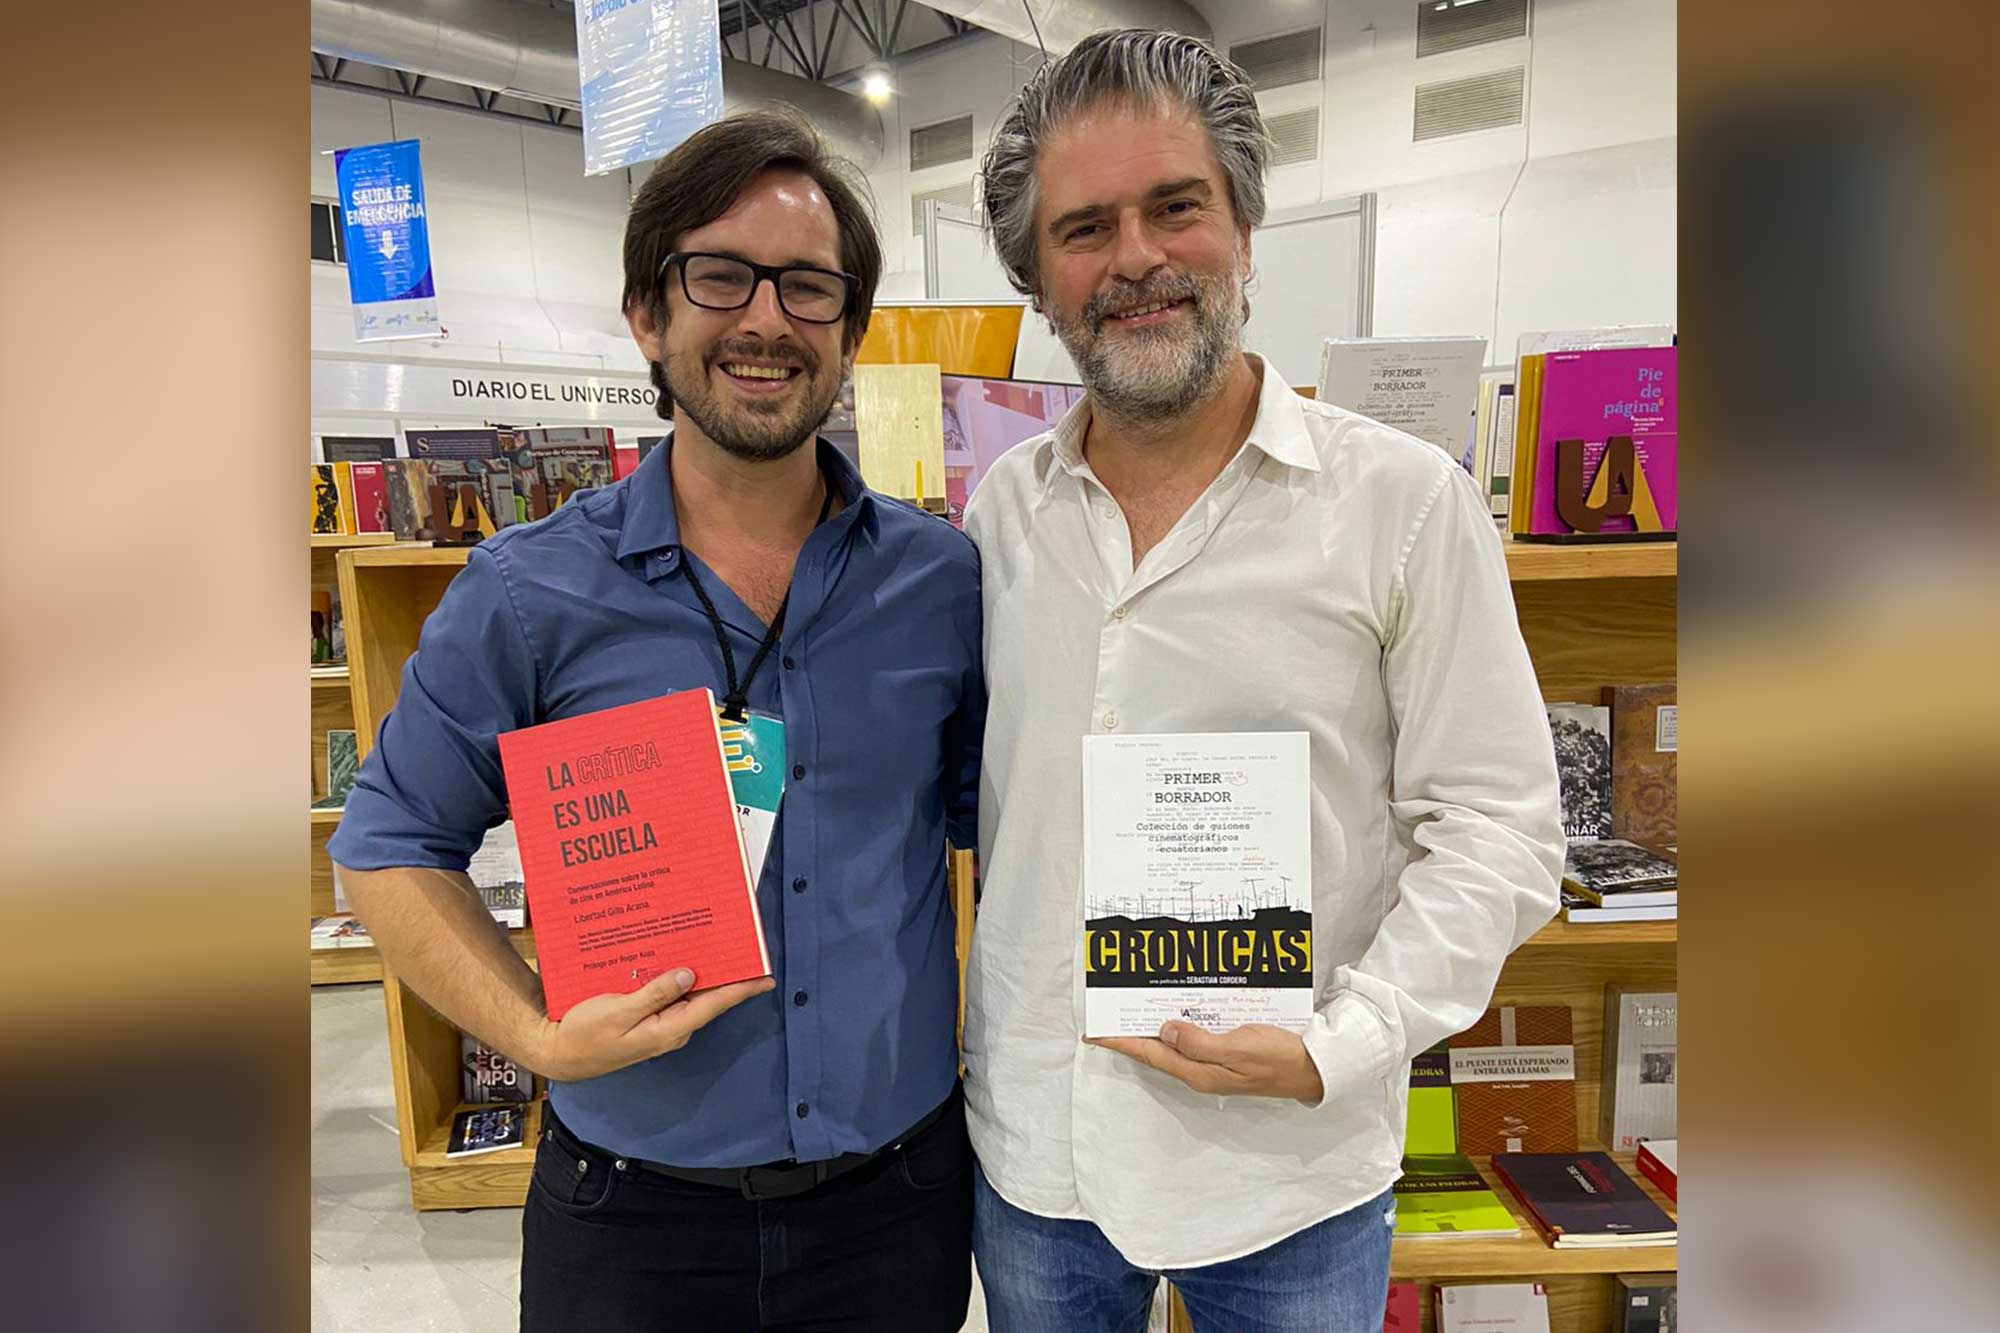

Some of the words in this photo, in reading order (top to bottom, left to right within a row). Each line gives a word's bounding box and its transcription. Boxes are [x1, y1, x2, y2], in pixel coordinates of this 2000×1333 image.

[395, 184, 412, 201] DE
[1382, 368, 1423, 378] PRIMER
[1638, 368, 1663, 382] Pie
[452, 379, 527, 400] DIARIO
[531, 383, 555, 401] EL
[561, 385, 656, 405] UNIVERSO
[1373, 381, 1427, 392] BORRADOR
[1640, 383, 1661, 398] de
[1603, 400, 1660, 419] página
[546, 762, 575, 791] LA
[576, 741, 662, 784] CRÍTICA
[1164, 773, 1222, 785] PRIMER
[1154, 791, 1232, 804] BORRADOR
[553, 800, 580, 830] ES
[584, 789, 631, 822] UNA
[1136, 822, 1189, 831] Colección
[1193, 823, 1205, 831] de
[1210, 823, 1251, 833] guiones
[560, 822, 658, 867] ESCUELA
[1148, 833, 1239, 843] cinematográficos
[1159, 845, 1229, 853] ecuatorianos
[567, 877, 620, 895] Conversaciones
[621, 873, 640, 883] sobre
[574, 909, 606, 924] Libertad
[1088, 929, 1309, 973] CRONICAS
[1186, 976, 1218, 985] SEBASTIAN
[1219, 976, 1248, 985] CORDERO
[1455, 1060, 1465, 1068] EL
[1466, 1059, 1498, 1068] PUENTE
[1519, 1057, 1569, 1067] ESPERANDO
[1473, 1067, 1498, 1075] ENTRE
[1500, 1067, 1516, 1075] LAS
[1517, 1066, 1550, 1075] LLAMAS
